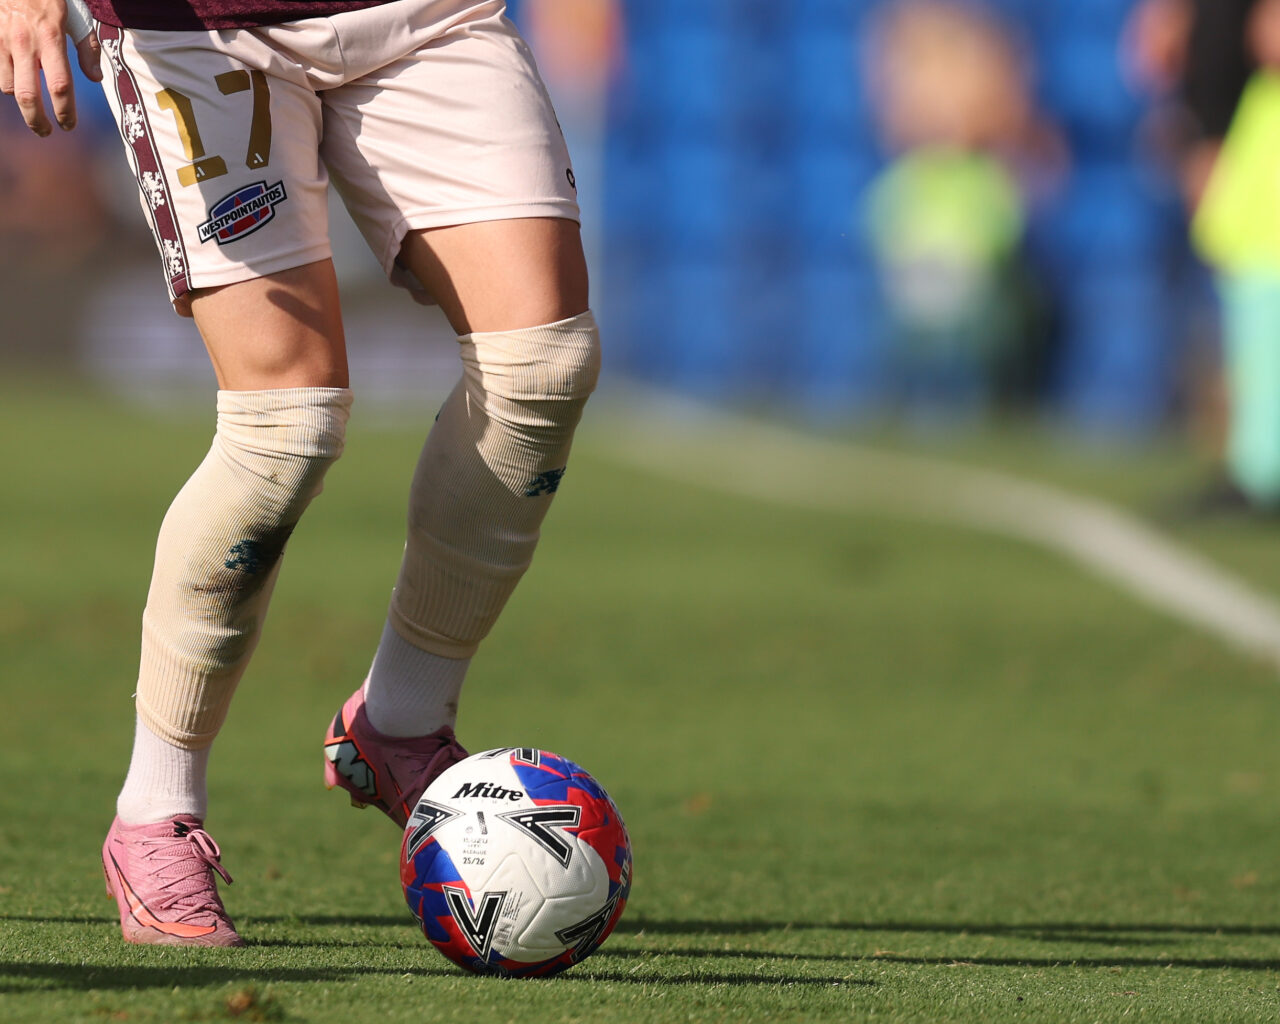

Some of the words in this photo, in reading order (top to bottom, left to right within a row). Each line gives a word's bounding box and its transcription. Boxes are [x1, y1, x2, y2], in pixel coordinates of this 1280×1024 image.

[155, 69, 272, 187] 17
[450, 782, 524, 802] Mitre
[462, 857, 485, 866] 25/26
